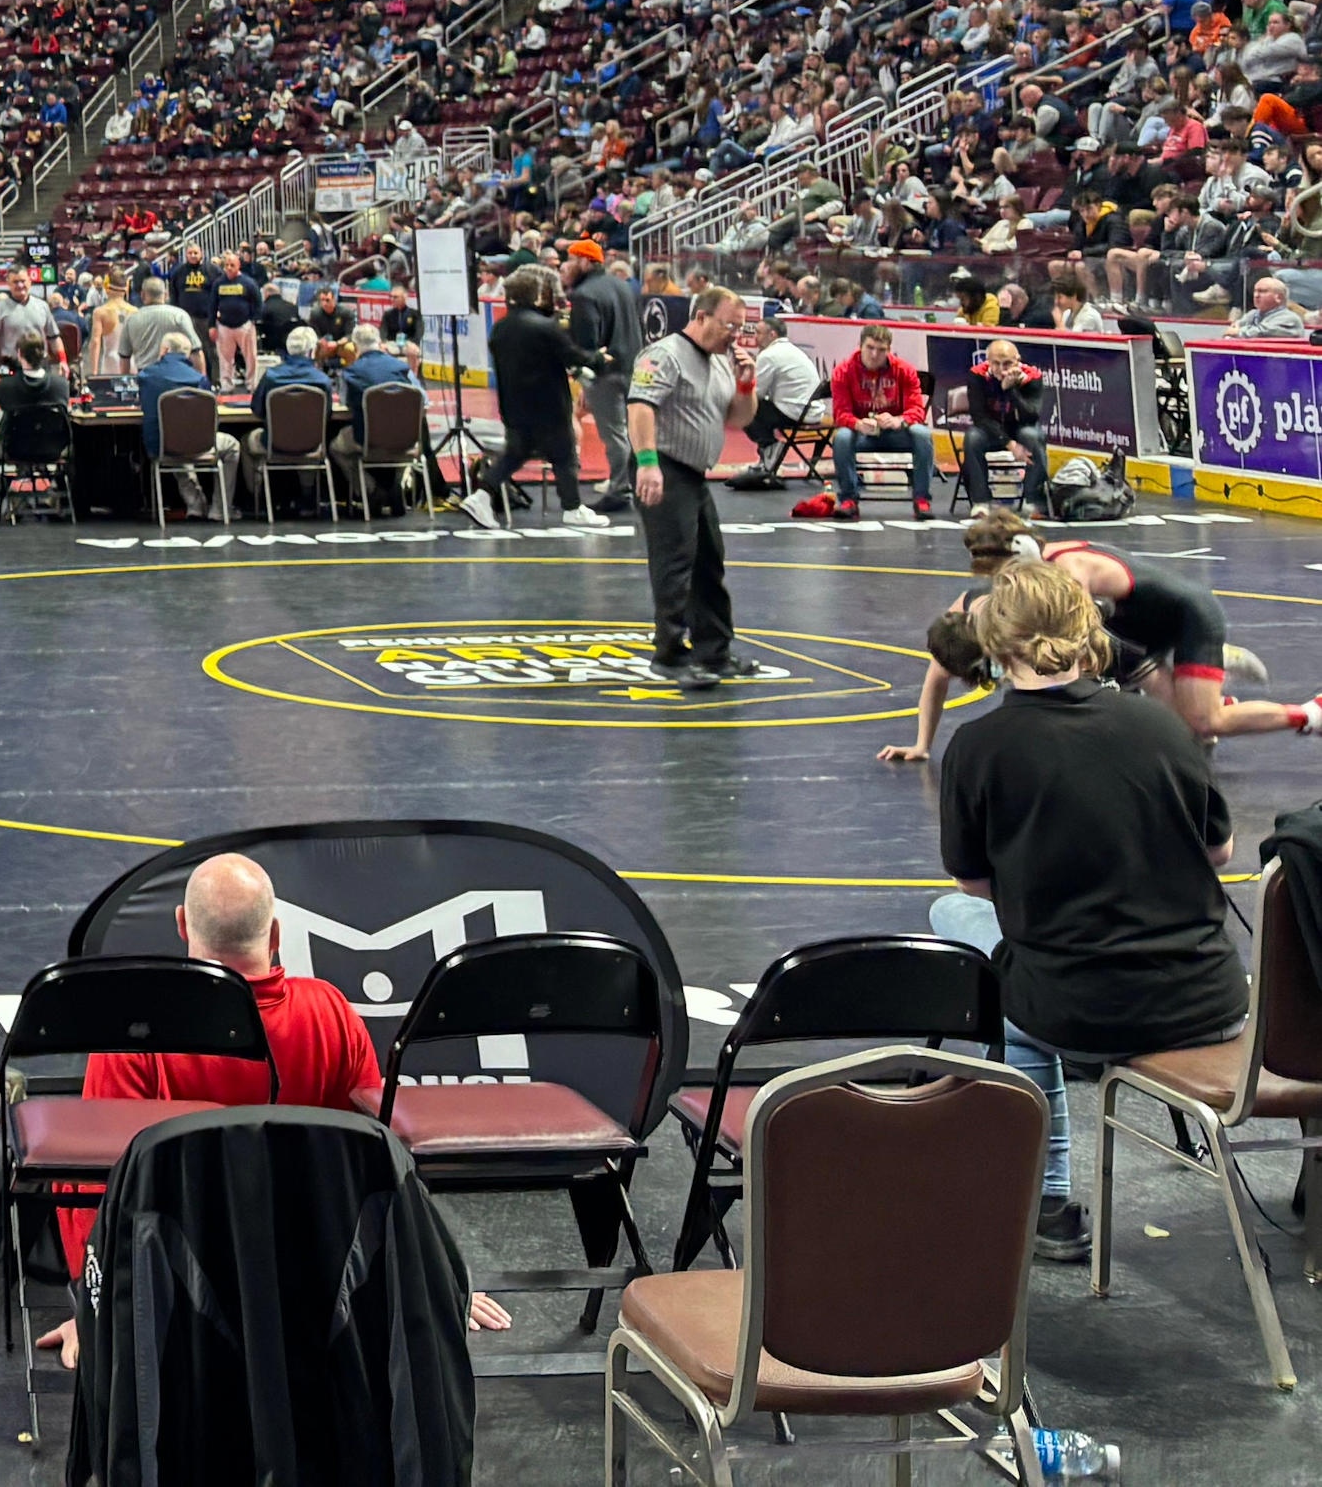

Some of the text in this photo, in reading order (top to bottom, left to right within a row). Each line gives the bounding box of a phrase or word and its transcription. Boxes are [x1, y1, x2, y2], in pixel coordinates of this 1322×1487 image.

[1060, 371, 1103, 393] Health
[1227, 393, 1251, 431] pf
[1072, 427, 1107, 447] Hershey
[1106, 430, 1130, 448] Bears
[379, 656, 653, 673] NATION
